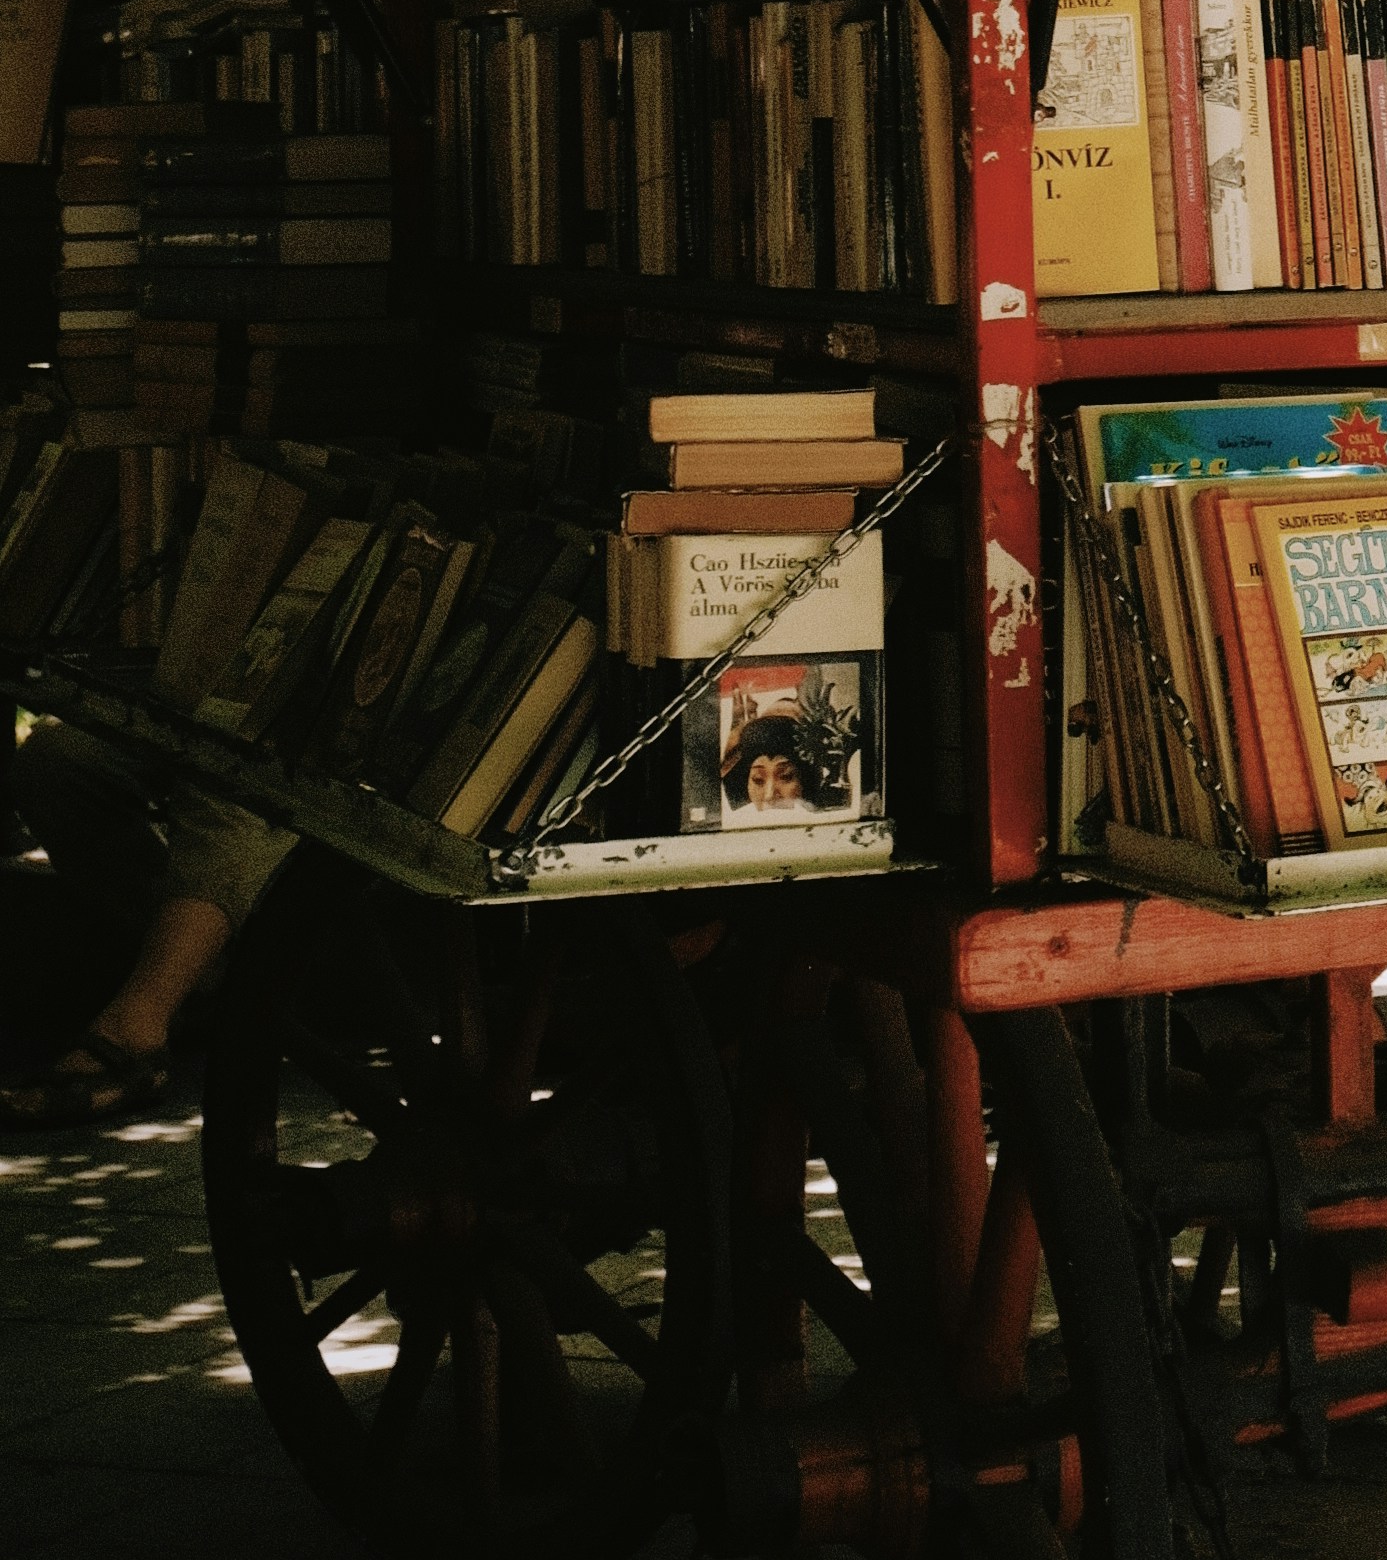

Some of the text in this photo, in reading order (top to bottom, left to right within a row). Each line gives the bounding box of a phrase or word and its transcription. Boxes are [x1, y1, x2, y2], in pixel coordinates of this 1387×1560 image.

[1241, 4, 1257, 64] gyerekkor
[1032, 142, 1114, 172] ÖNVÍZ
[1044, 180, 1061, 200] I.
[1277, 515, 1312, 530] SAJDIK
[1312, 512, 1348, 527] FERENC
[689, 552, 729, 573] Cao
[690, 577, 706, 595] A
[719, 574, 775, 594] Vörös
[689, 598, 739, 617] álma
